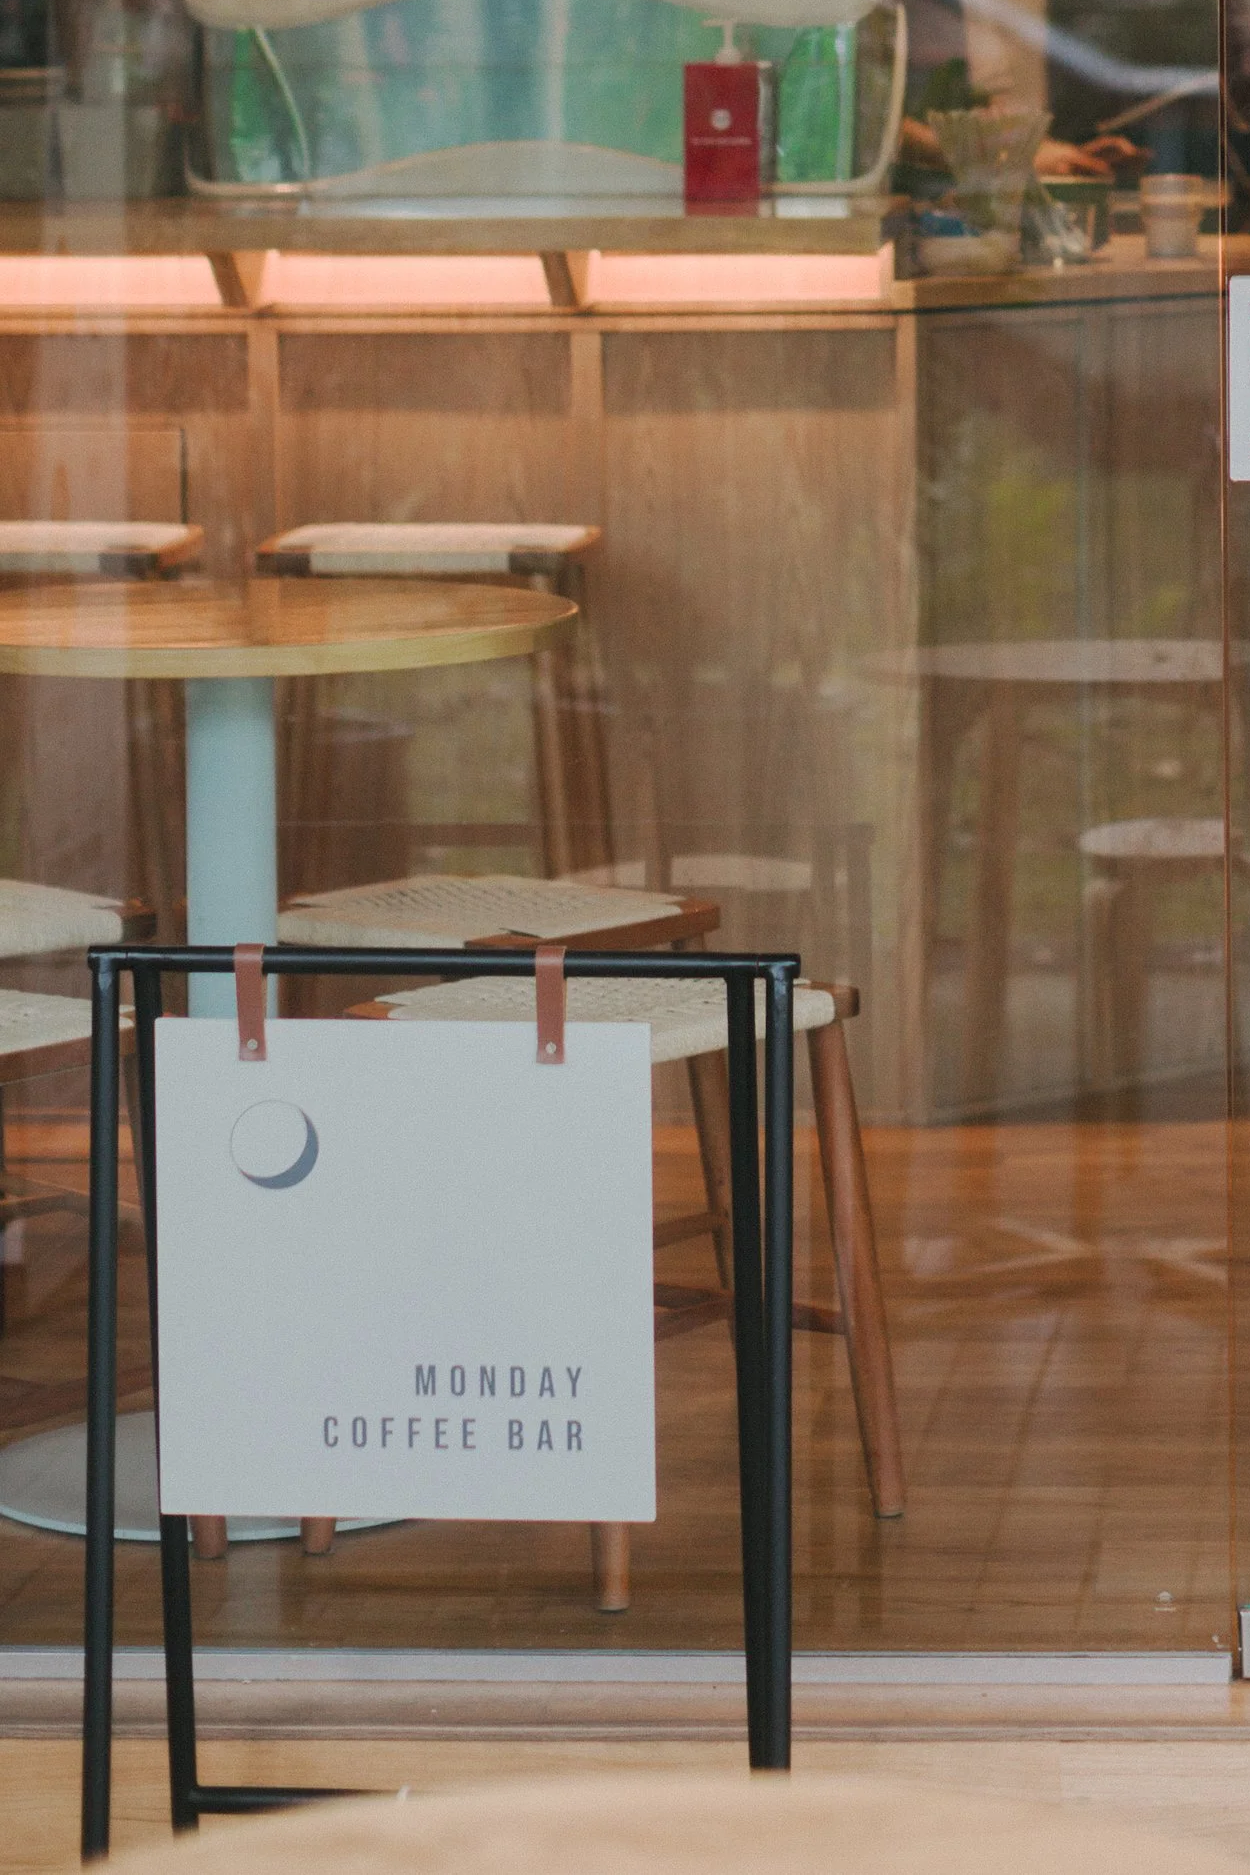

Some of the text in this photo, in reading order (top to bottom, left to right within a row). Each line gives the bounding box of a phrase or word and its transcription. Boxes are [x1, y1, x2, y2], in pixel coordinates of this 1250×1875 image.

[415, 1364, 583, 1398] MONDAY
[322, 1416, 583, 1451] COFFEE BAR
